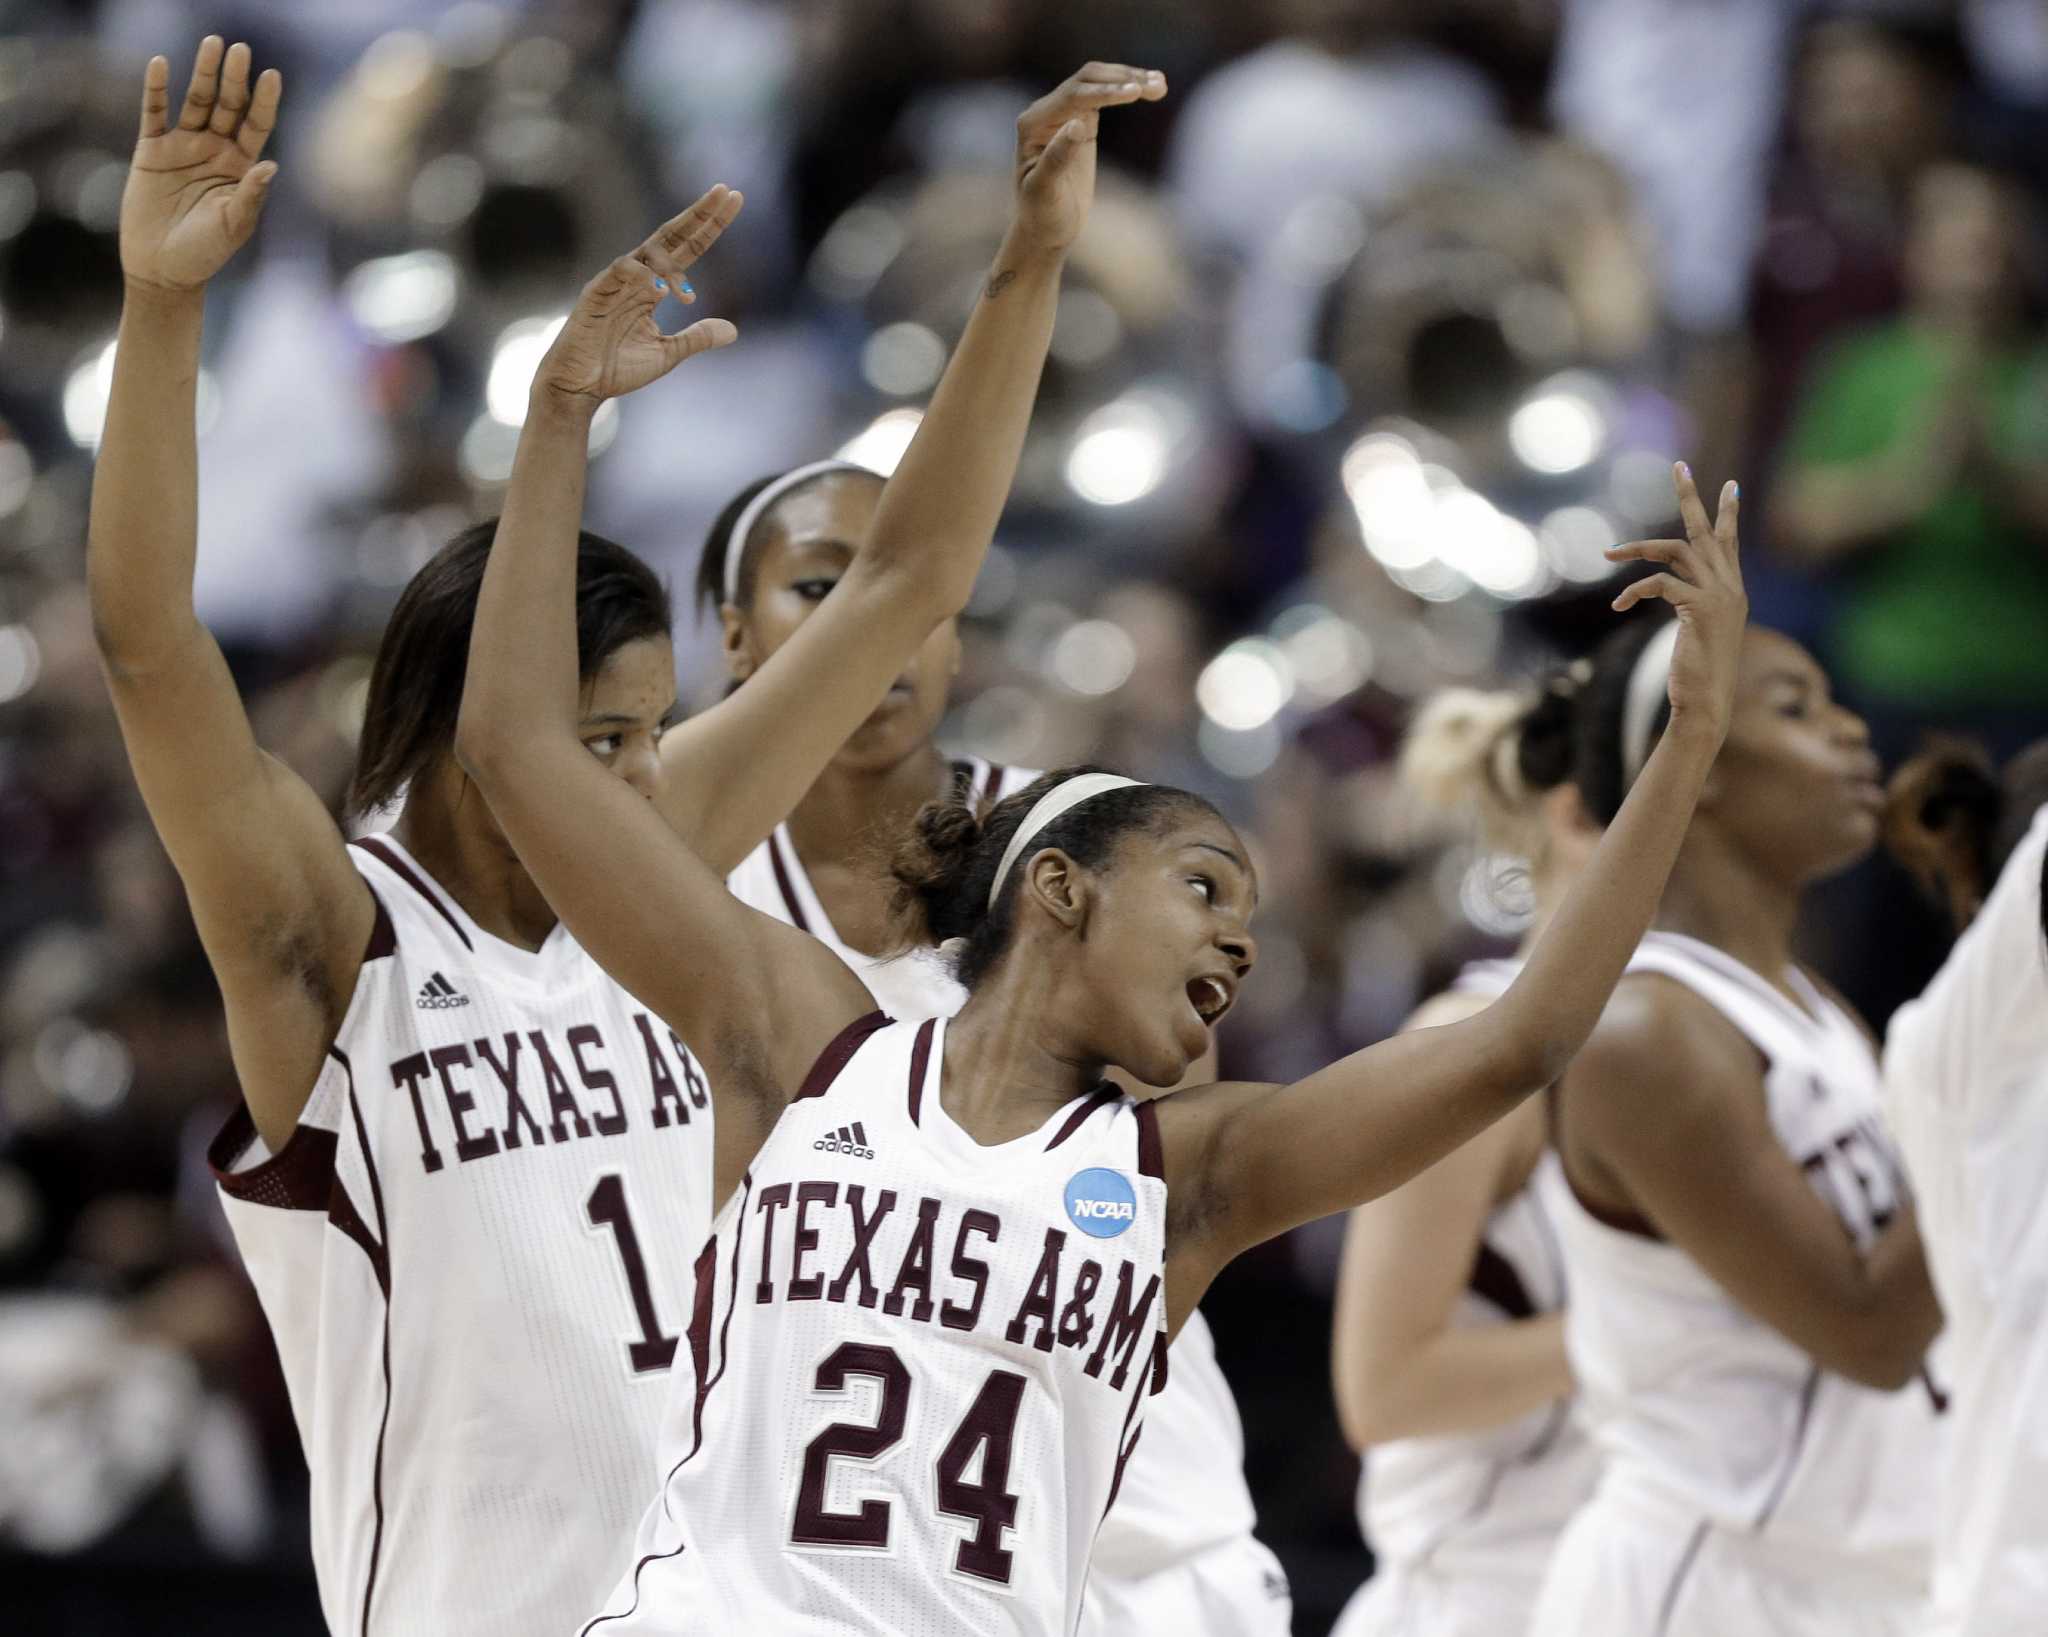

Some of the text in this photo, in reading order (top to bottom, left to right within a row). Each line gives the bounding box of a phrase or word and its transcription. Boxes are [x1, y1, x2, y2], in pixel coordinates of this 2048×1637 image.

[416, 994, 469, 1010] adidas
[389, 1013, 708, 1174] TEXAS A&
[813, 1140, 875, 1160] adidas
[586, 1173, 680, 1373] 1
[756, 1181, 1161, 1392] TEXAS A&M
[1074, 1199, 1133, 1220] NCAA
[790, 1341, 1028, 1585] 24
